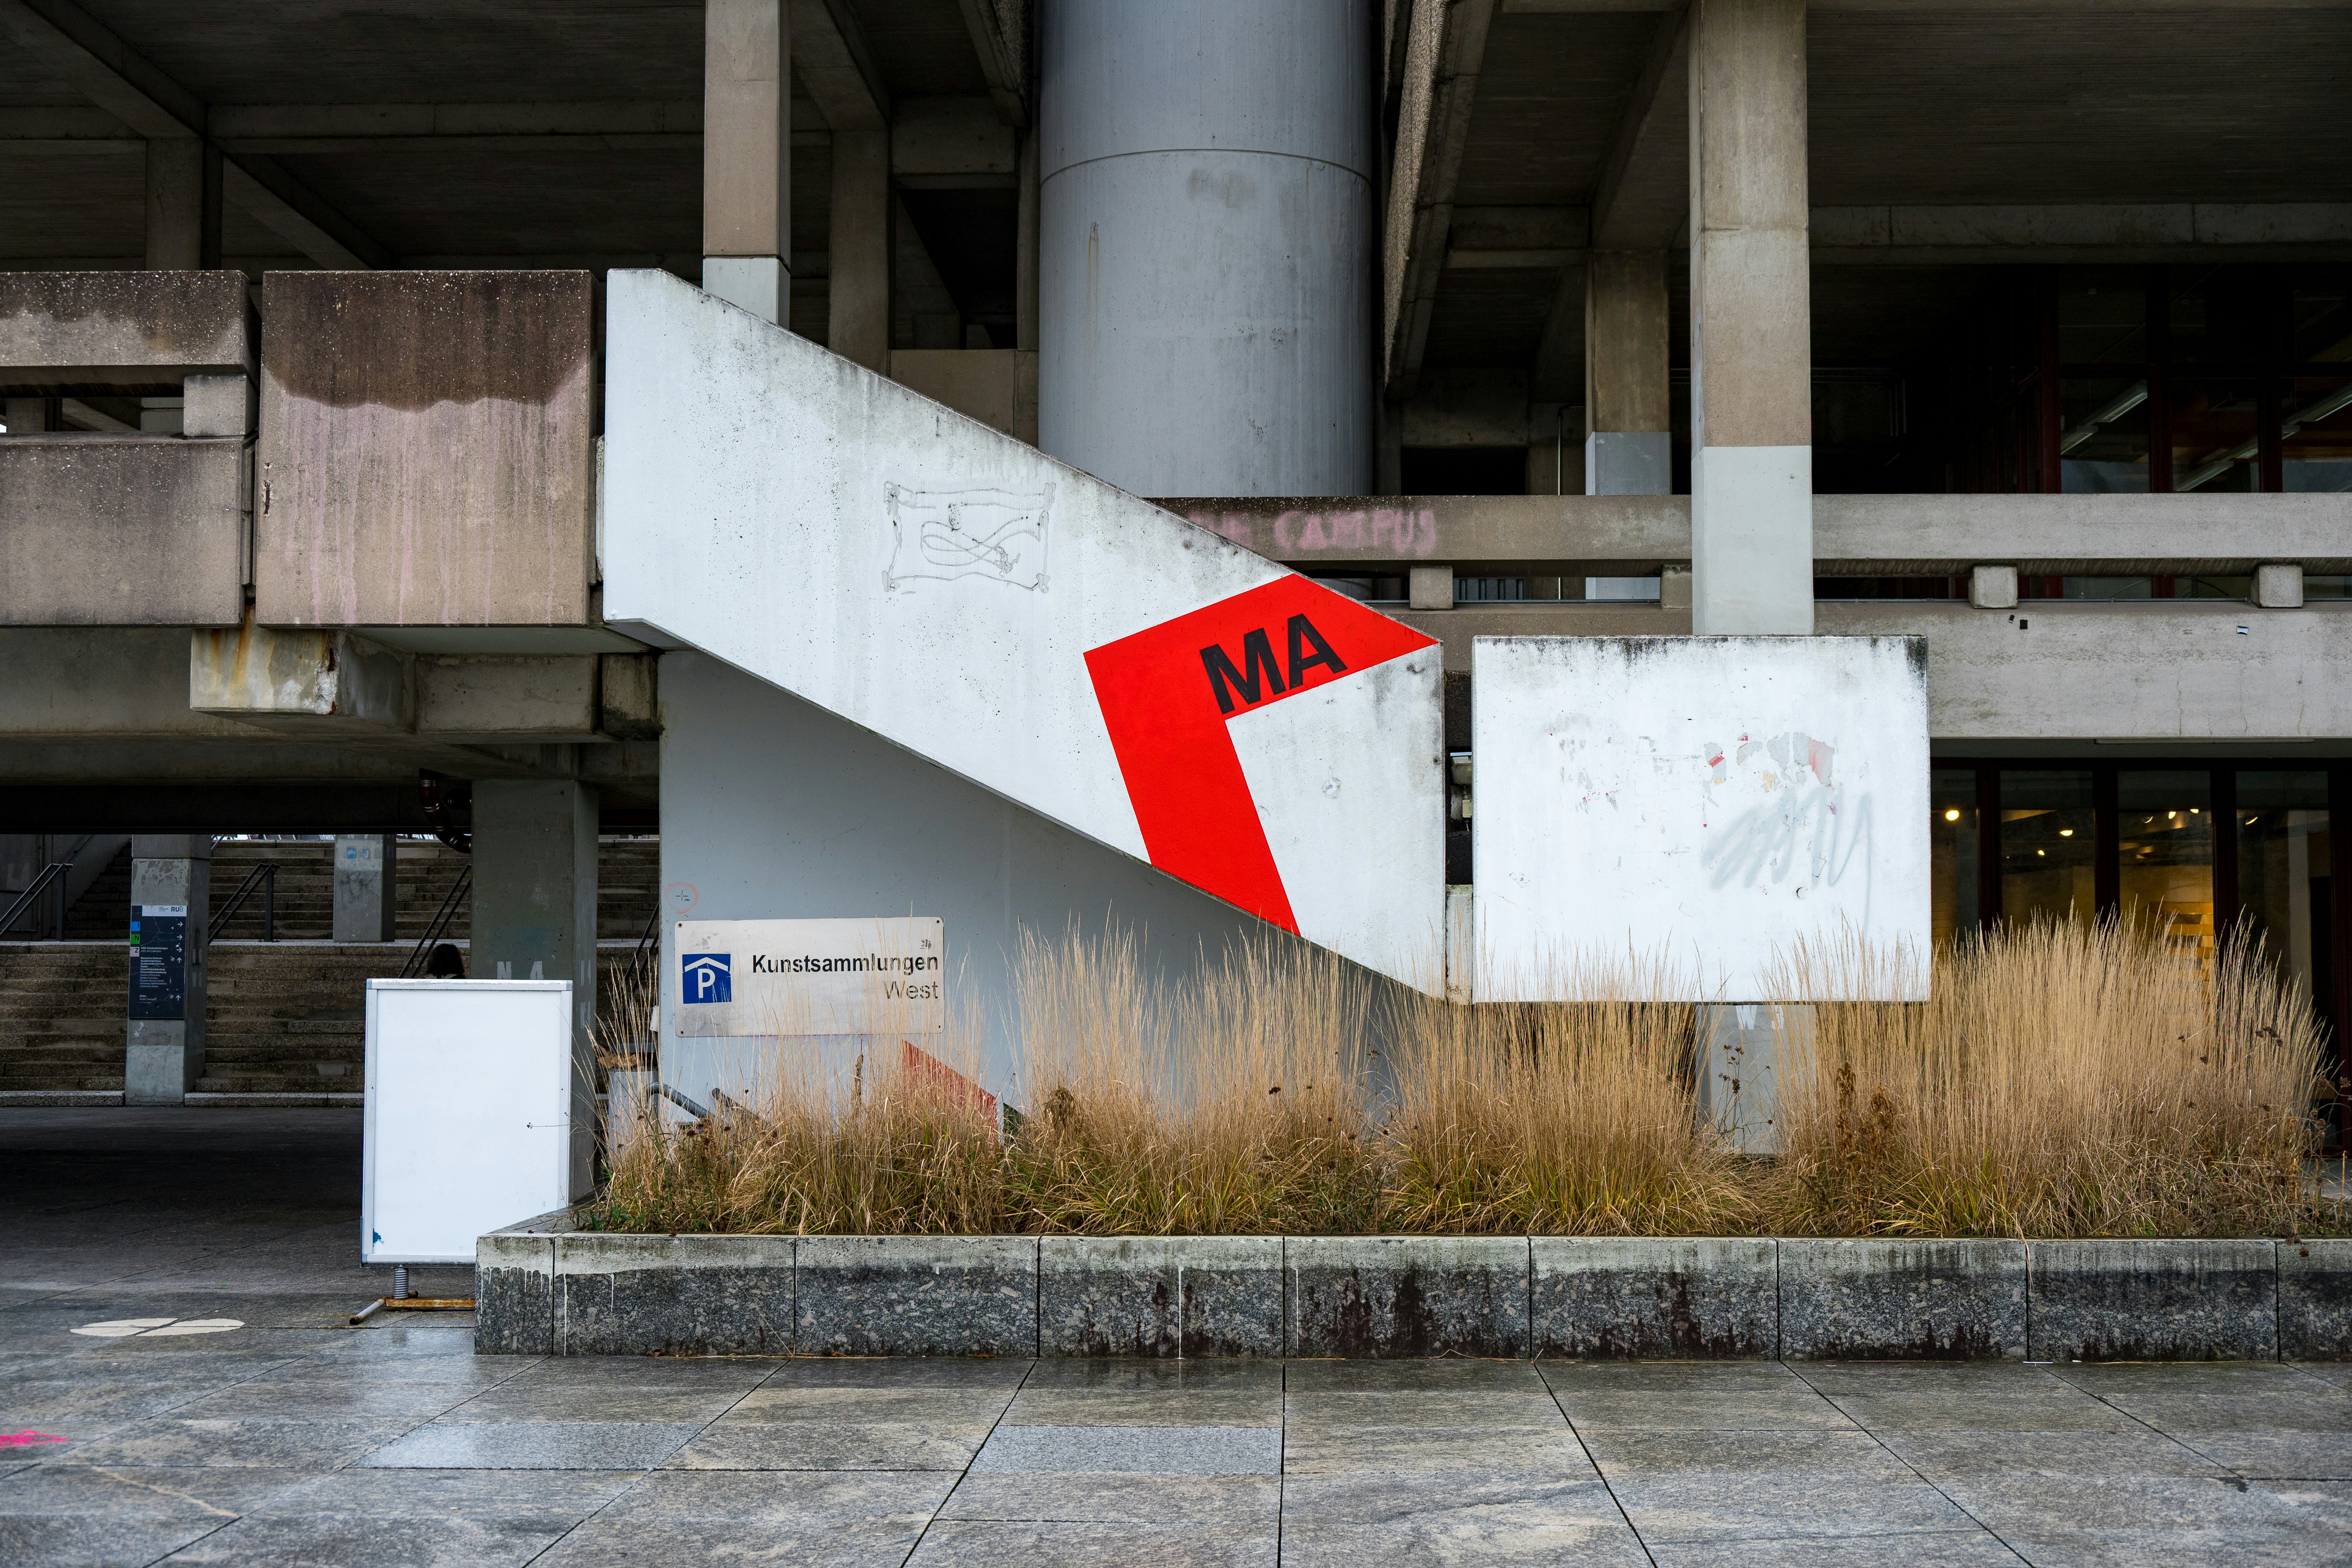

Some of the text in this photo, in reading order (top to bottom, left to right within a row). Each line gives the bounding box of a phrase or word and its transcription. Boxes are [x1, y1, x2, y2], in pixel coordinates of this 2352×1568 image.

[1274, 509, 1436, 557] CAMPUS
[1199, 613, 1347, 714] MA
[497, 961, 511, 979] N
[752, 953, 938, 975] Kunstsammlungen
[698, 969, 715, 998] P
[883, 981, 938, 1000] West
[1736, 1005, 1757, 1030] W
